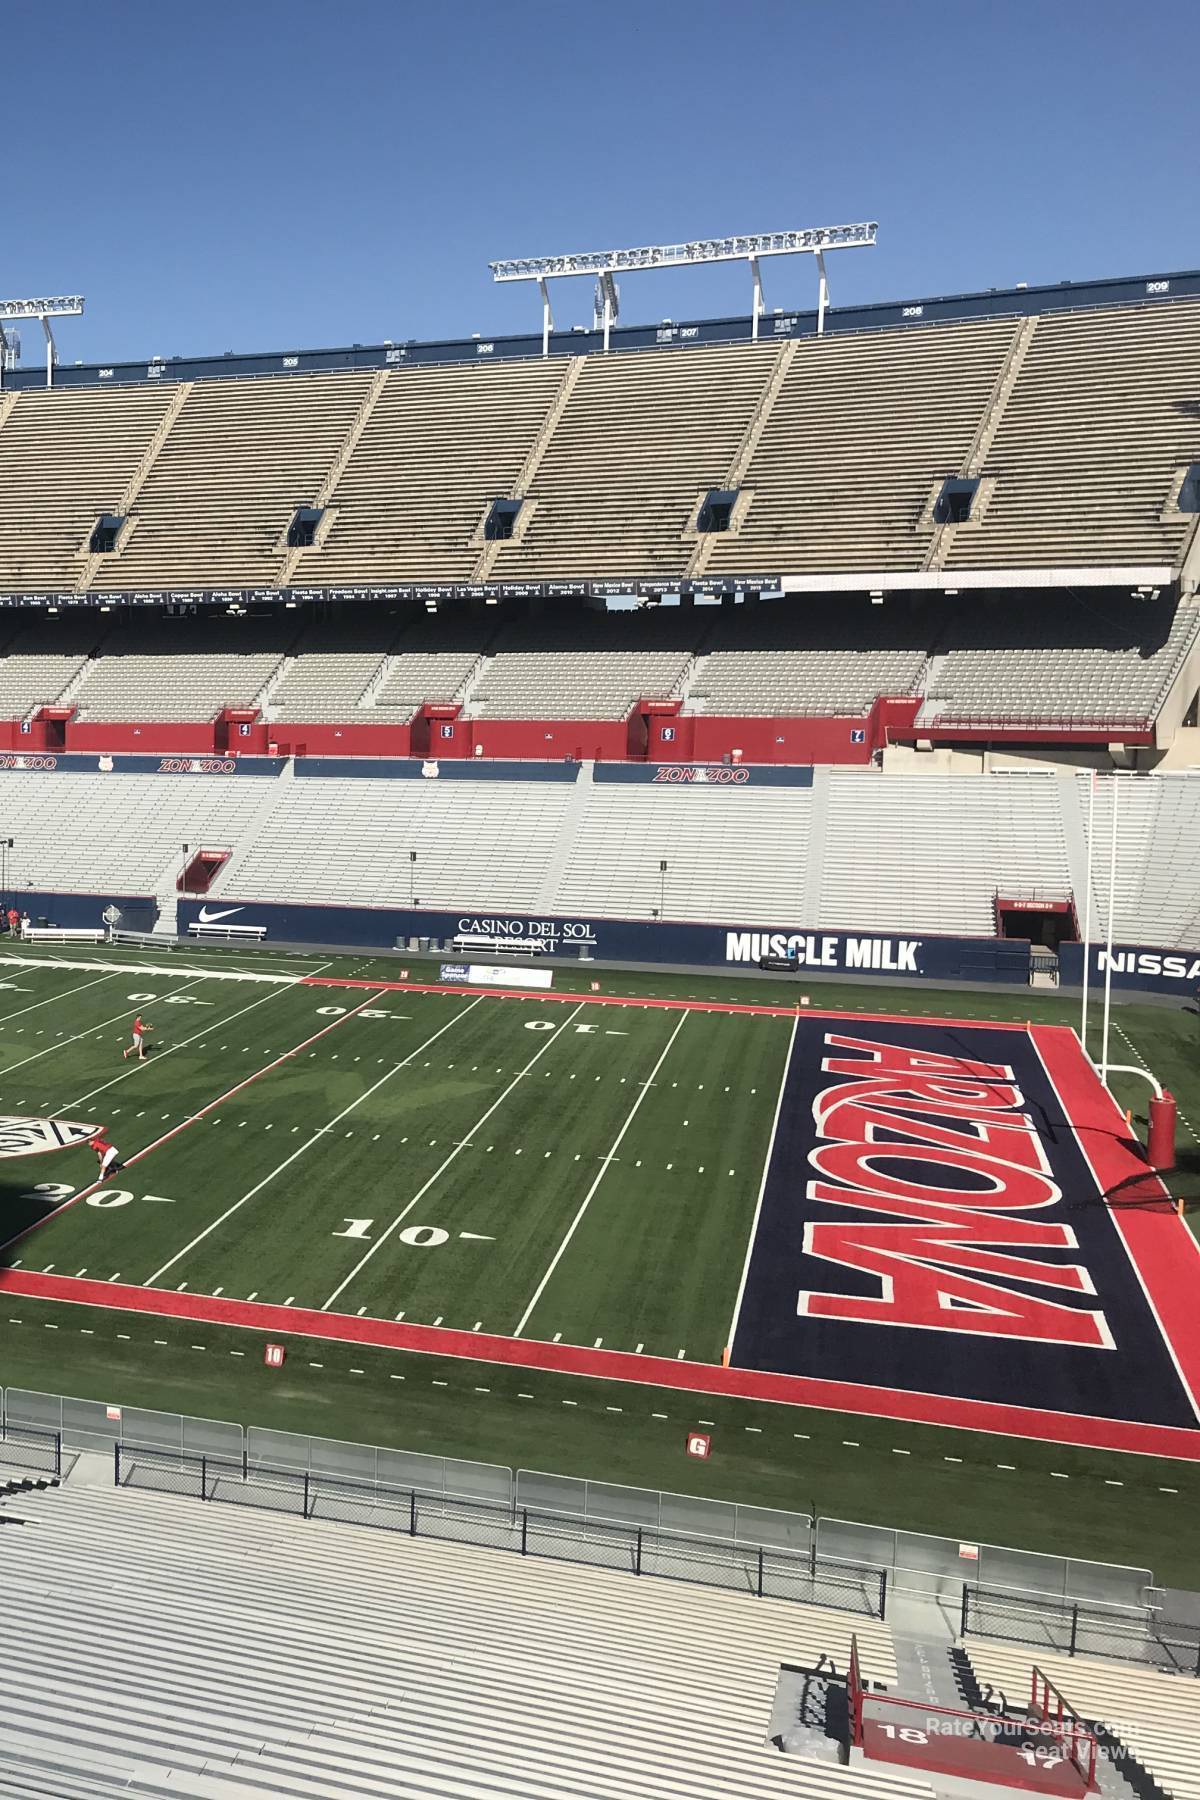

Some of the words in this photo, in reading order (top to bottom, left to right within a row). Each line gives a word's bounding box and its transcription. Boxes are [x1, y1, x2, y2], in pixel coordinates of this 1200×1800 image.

[1147, 282, 1168, 291] 209
[903, 307, 922, 316] 208
[681, 329, 697, 337] 207
[458, 918, 523, 935] CASINO
[528, 921, 560, 937] DEL
[563, 923, 596, 938] SOL
[726, 932, 838, 967] MUSCLE
[846, 938, 918, 971] MILK
[126, 993, 199, 1005] 30
[316, 1006, 392, 1019] 20
[523, 1020, 603, 1034] 10
[19, 1182, 135, 1209] 20
[796, 1033, 1117, 1350] ARIZONA
[332, 1218, 450, 1247] 10
[267, 1347, 281, 1363] 10
[689, 1438, 707, 1456] G
[877, 1722, 929, 1746] 18
[1017, 1752, 1064, 1769] 17
